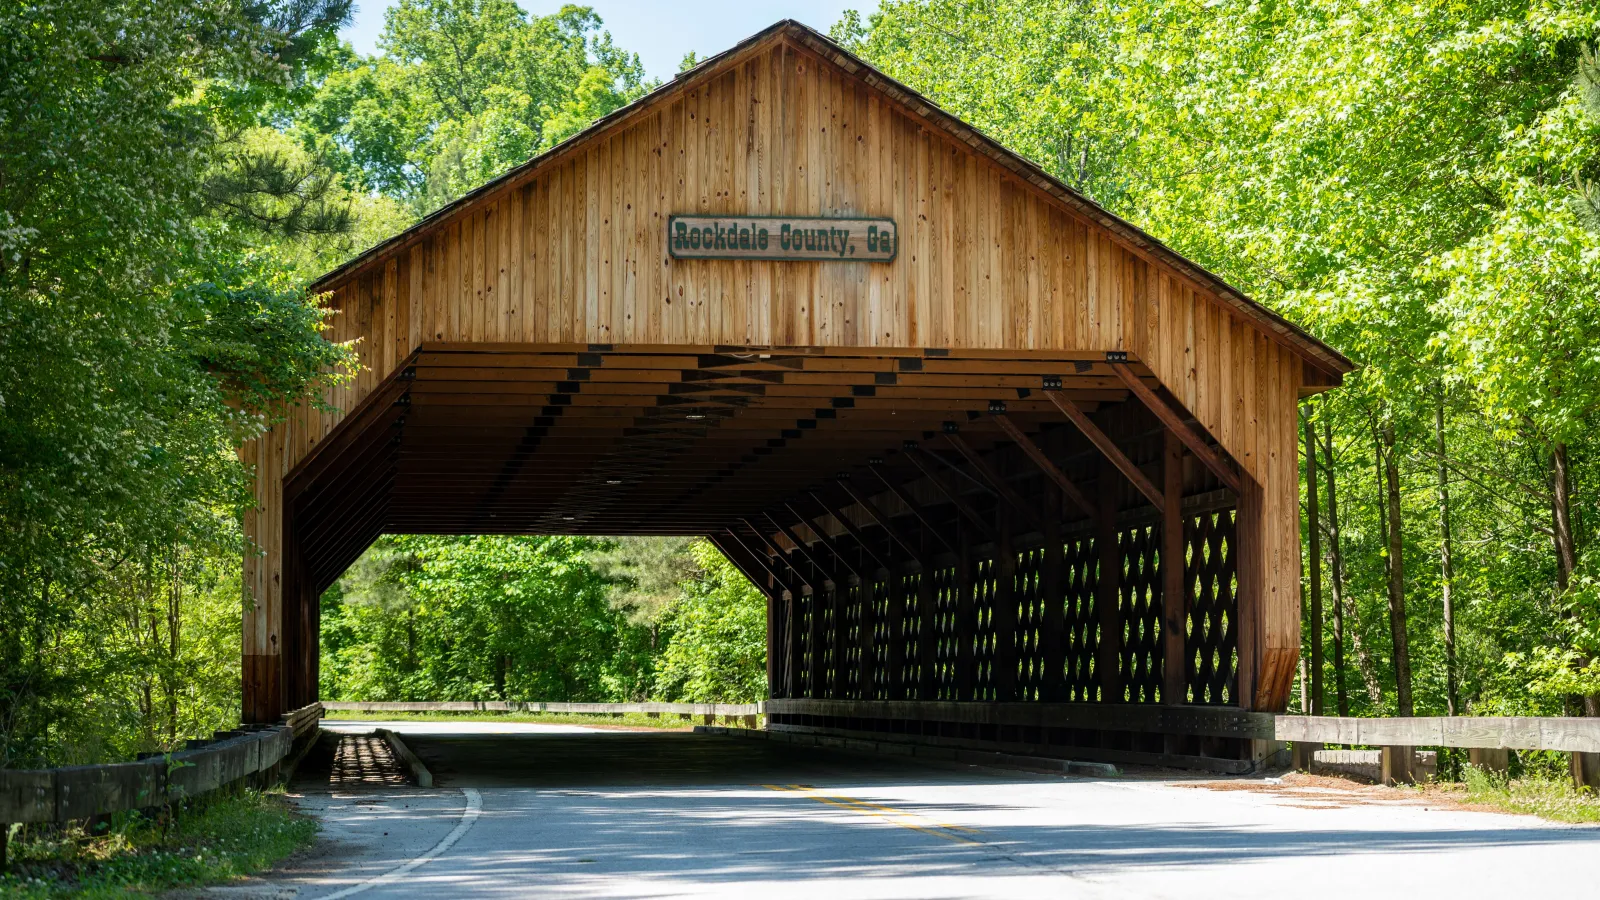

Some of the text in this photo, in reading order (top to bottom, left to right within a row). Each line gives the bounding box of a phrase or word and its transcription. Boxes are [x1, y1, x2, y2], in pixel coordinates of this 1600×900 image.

[675, 222, 892, 257] Rockdale County, Ga
